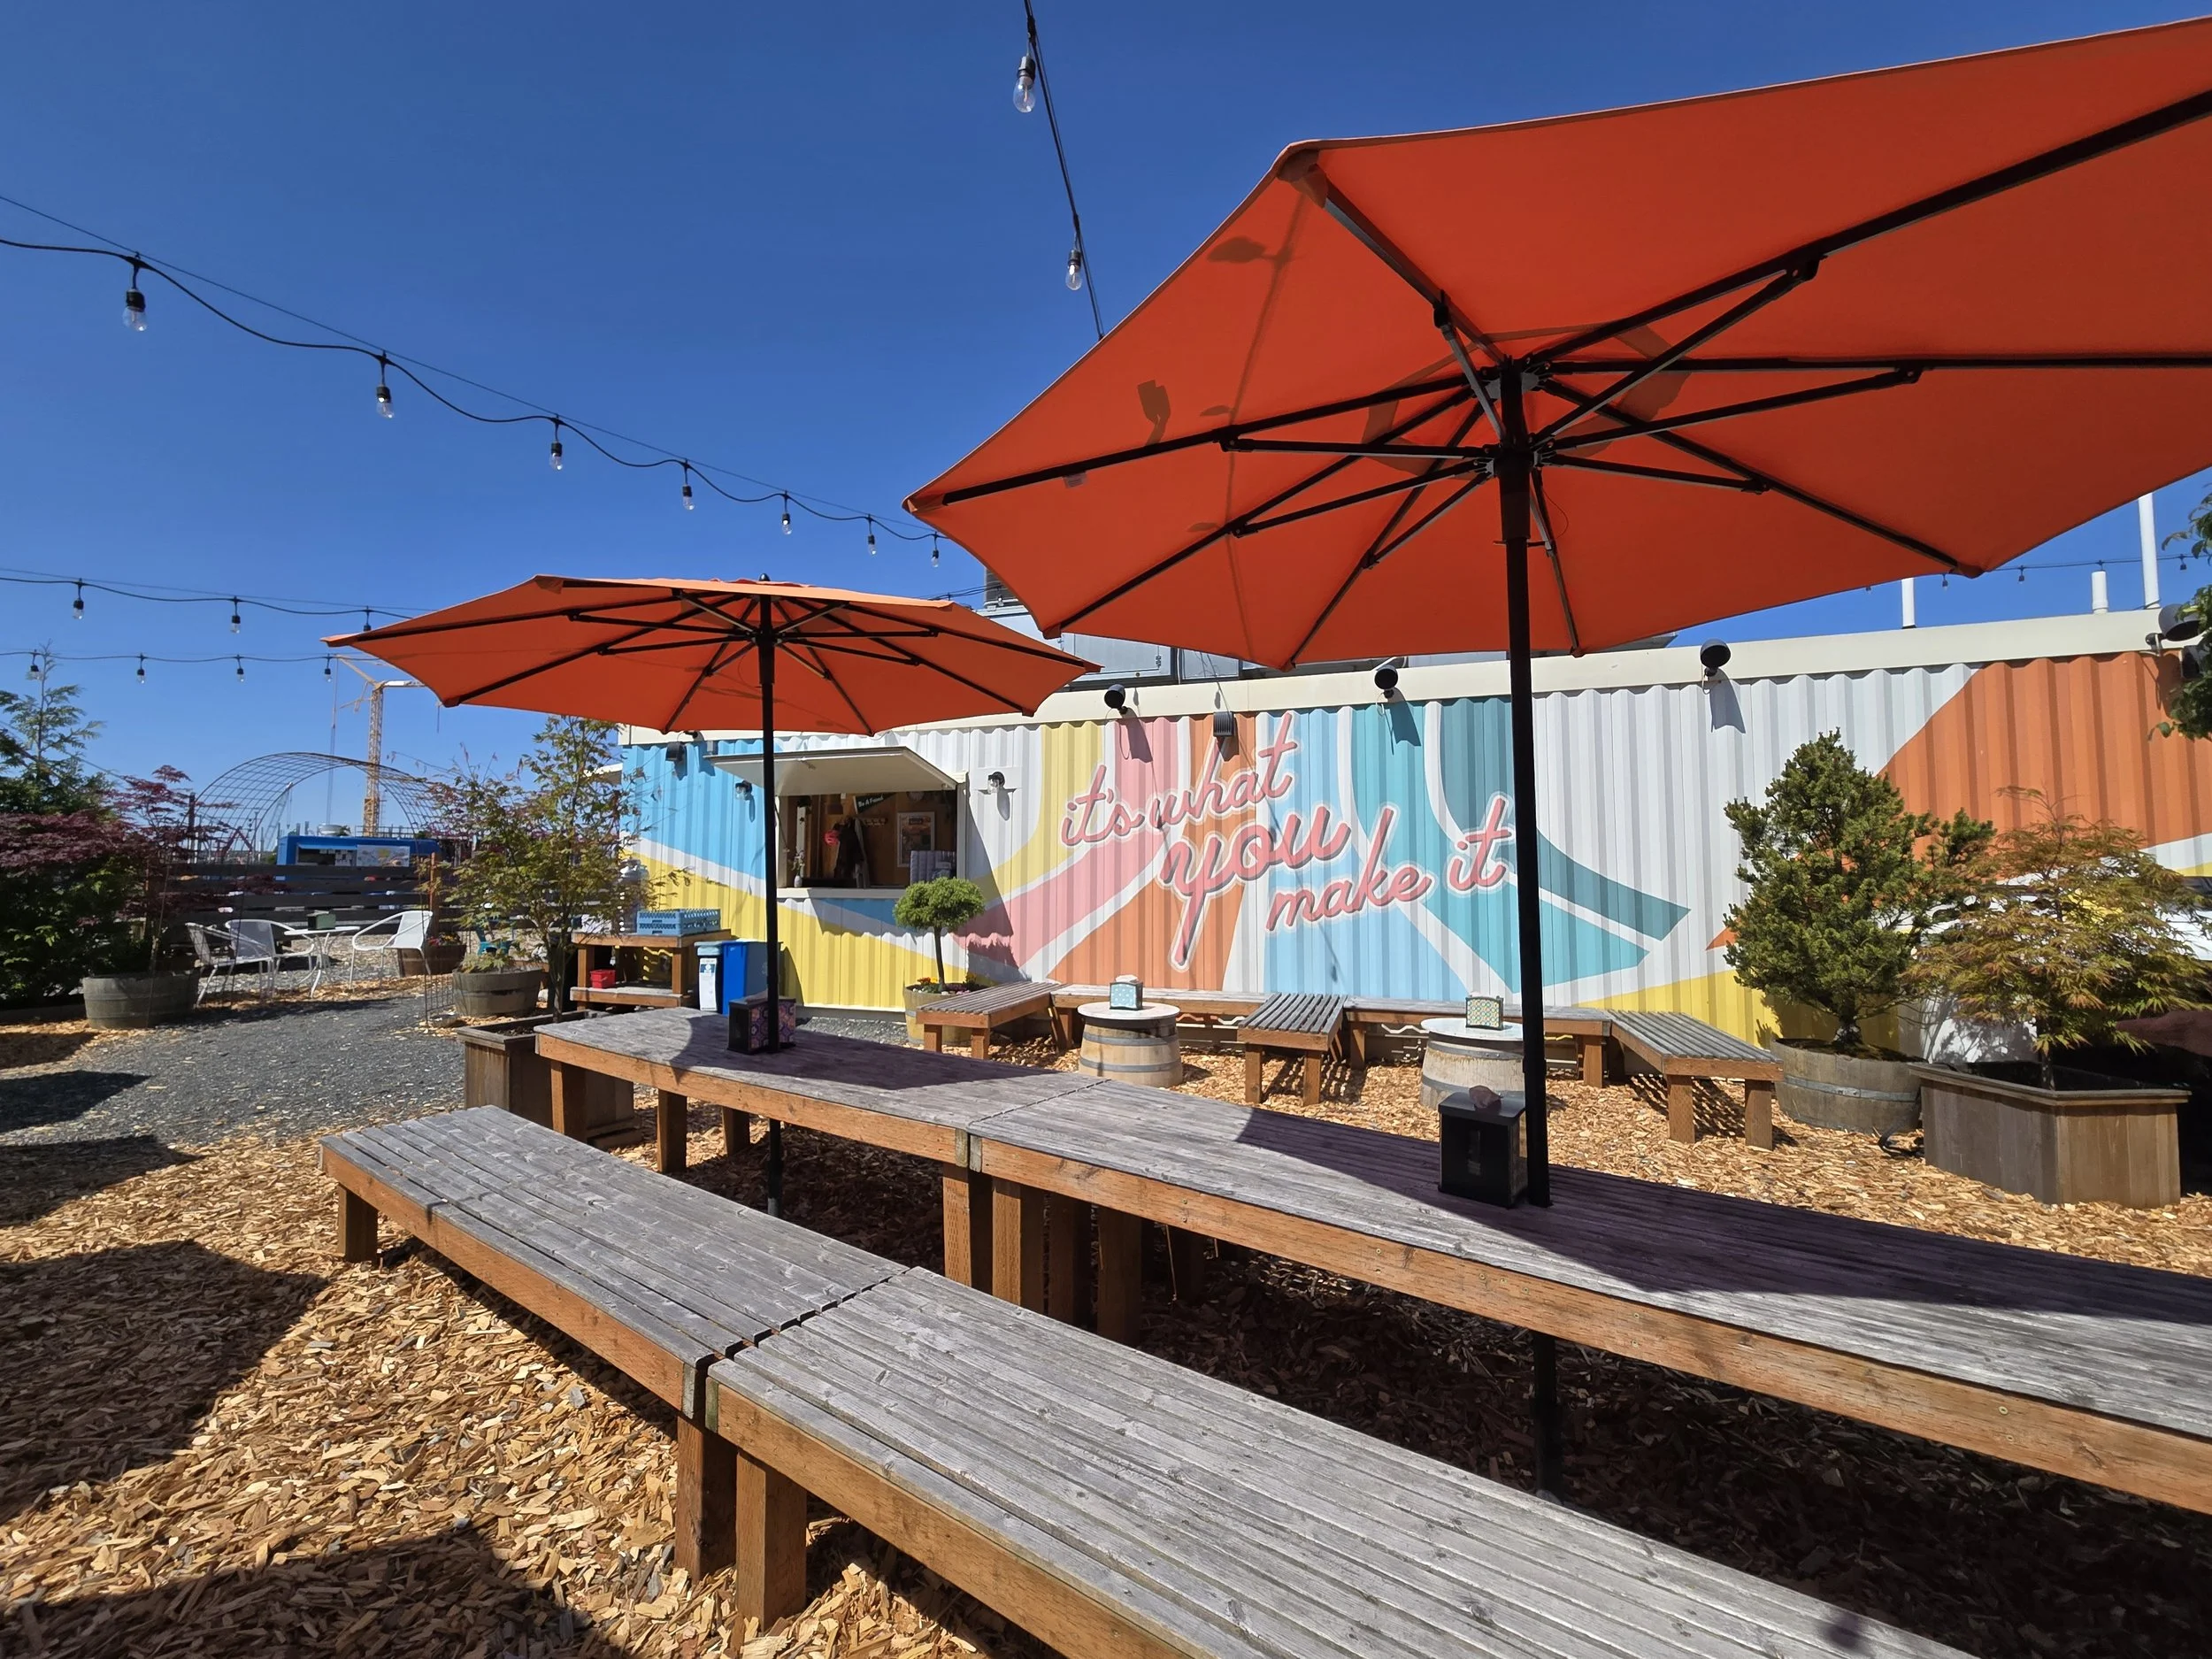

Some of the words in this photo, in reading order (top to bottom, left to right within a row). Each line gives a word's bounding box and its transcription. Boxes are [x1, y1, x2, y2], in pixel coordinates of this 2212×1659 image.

[1061, 764, 1145, 847] it's
[1149, 711, 1298, 829] what
[1159, 806, 1352, 966] you
[1265, 807, 1432, 932] make
[1448, 797, 1512, 892] it
